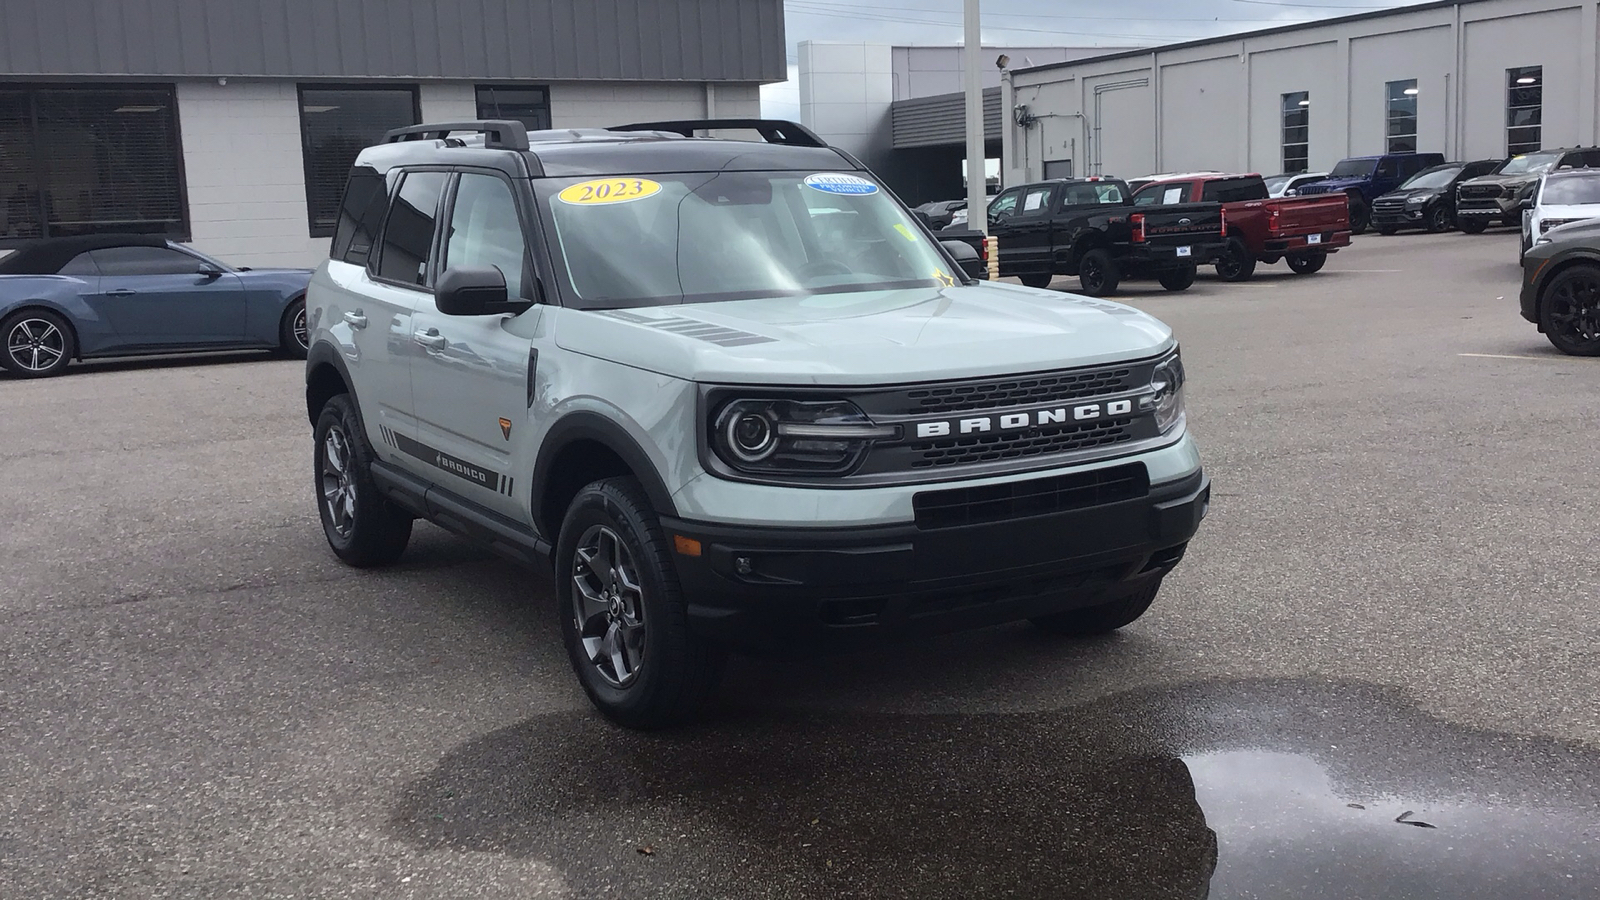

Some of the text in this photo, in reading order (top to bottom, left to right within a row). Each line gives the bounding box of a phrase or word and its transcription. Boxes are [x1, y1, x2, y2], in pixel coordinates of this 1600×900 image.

[579, 180, 643, 201] 2023
[917, 400, 1132, 438] BRONCO
[442, 457, 486, 482] BRONCO
